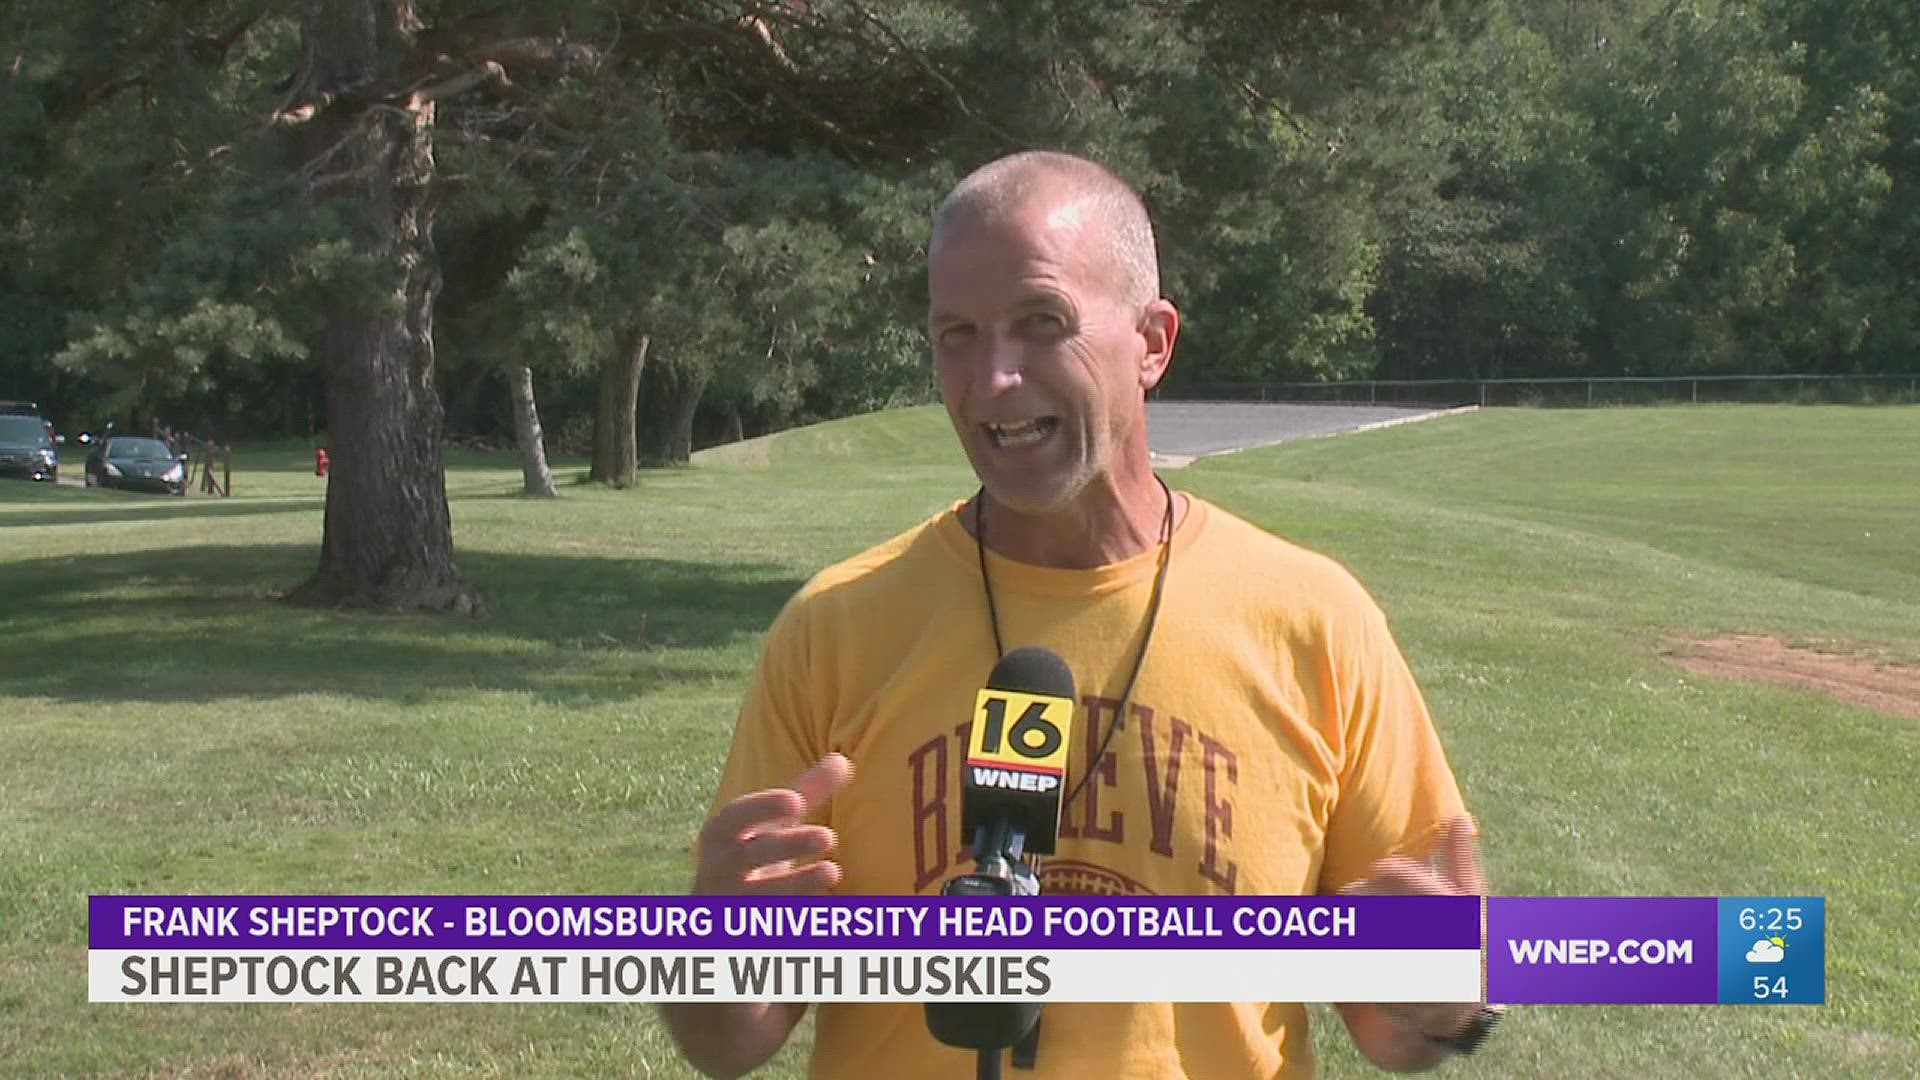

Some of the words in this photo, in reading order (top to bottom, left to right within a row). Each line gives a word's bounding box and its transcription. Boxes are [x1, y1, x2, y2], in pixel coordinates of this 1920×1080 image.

[981, 697, 1062, 759] 16
[908, 694, 1238, 893] BEVE
[973, 767, 1059, 793] WNEP
